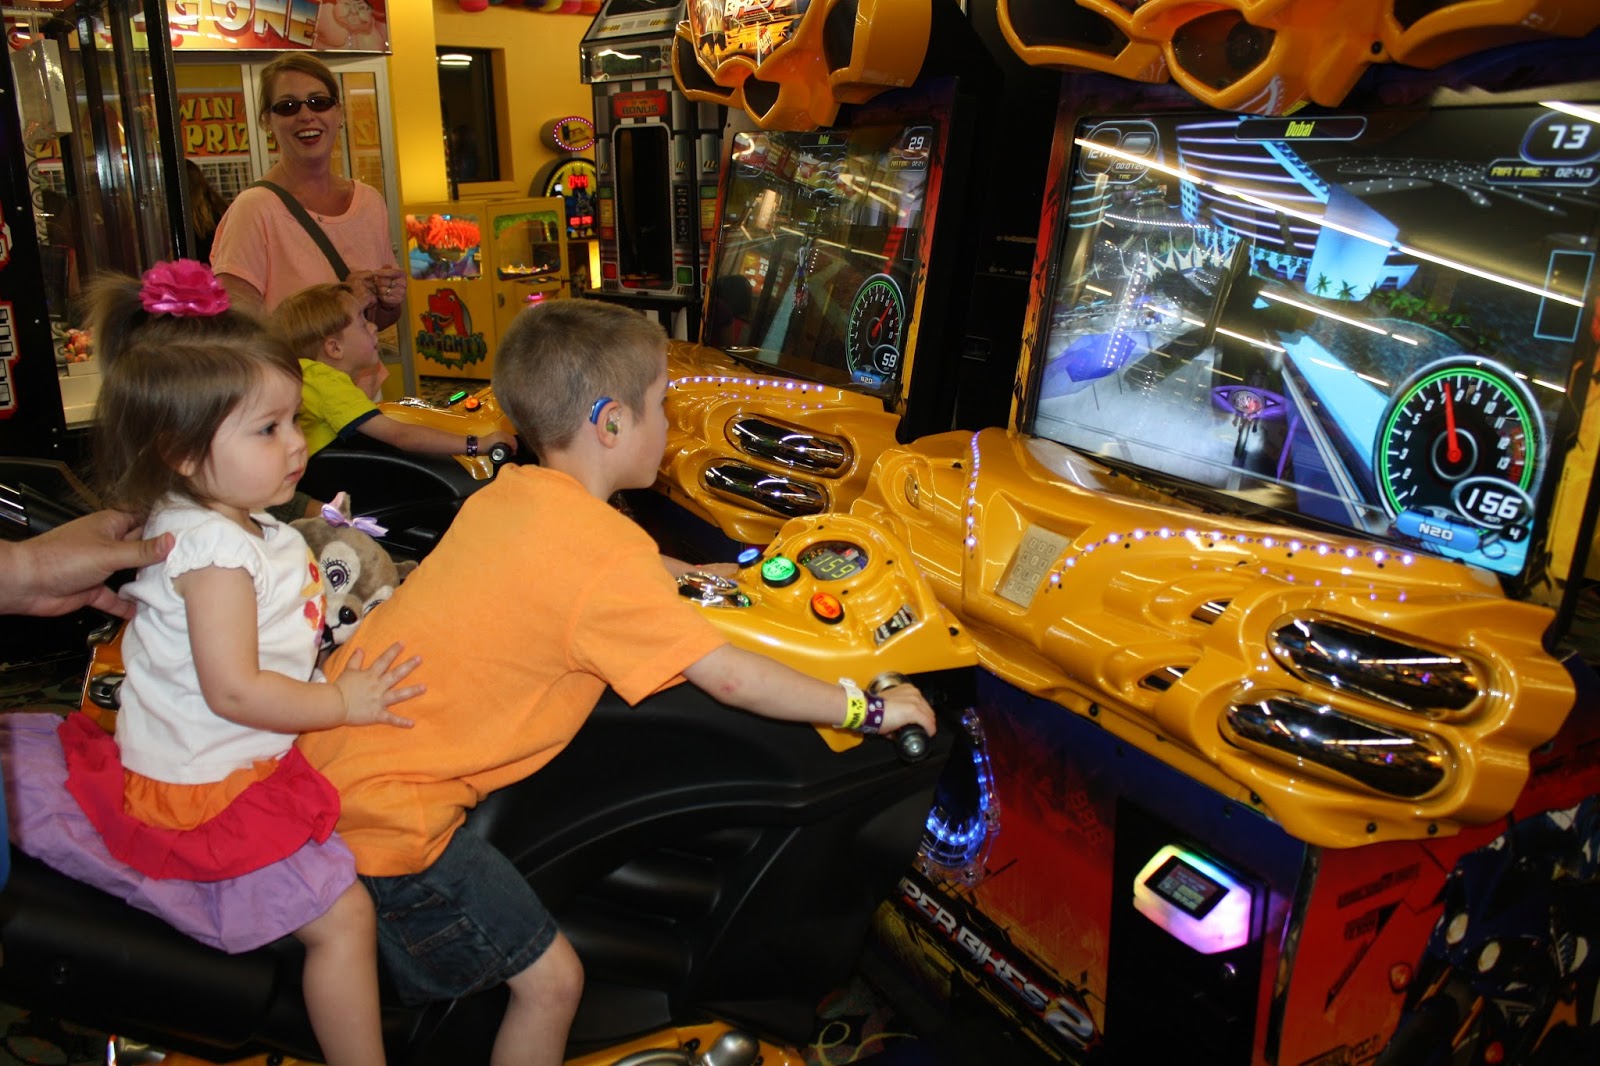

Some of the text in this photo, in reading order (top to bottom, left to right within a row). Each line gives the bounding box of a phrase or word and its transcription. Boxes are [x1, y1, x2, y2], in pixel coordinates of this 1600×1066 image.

[622, 105, 658, 115] BONUS
[1285, 121, 1315, 137] Dubai
[908, 136, 925, 150] 29
[1548, 125, 1591, 149] 73
[1554, 167, 1594, 178] 02:43
[881, 353, 897, 368] 59
[1471, 392, 1481, 405] 9
[1483, 401, 1497, 414] 10
[1412, 413, 1422, 425] 5
[1404, 430, 1412, 442] 4
[1399, 448, 1409, 460] 3
[1402, 468, 1412, 479] 2
[1466, 488, 1523, 519] 156
[1509, 528, 1521, 540] 4
[816, 555, 855, 578] 159
[900, 877, 1094, 1050] PER BIKES 2
